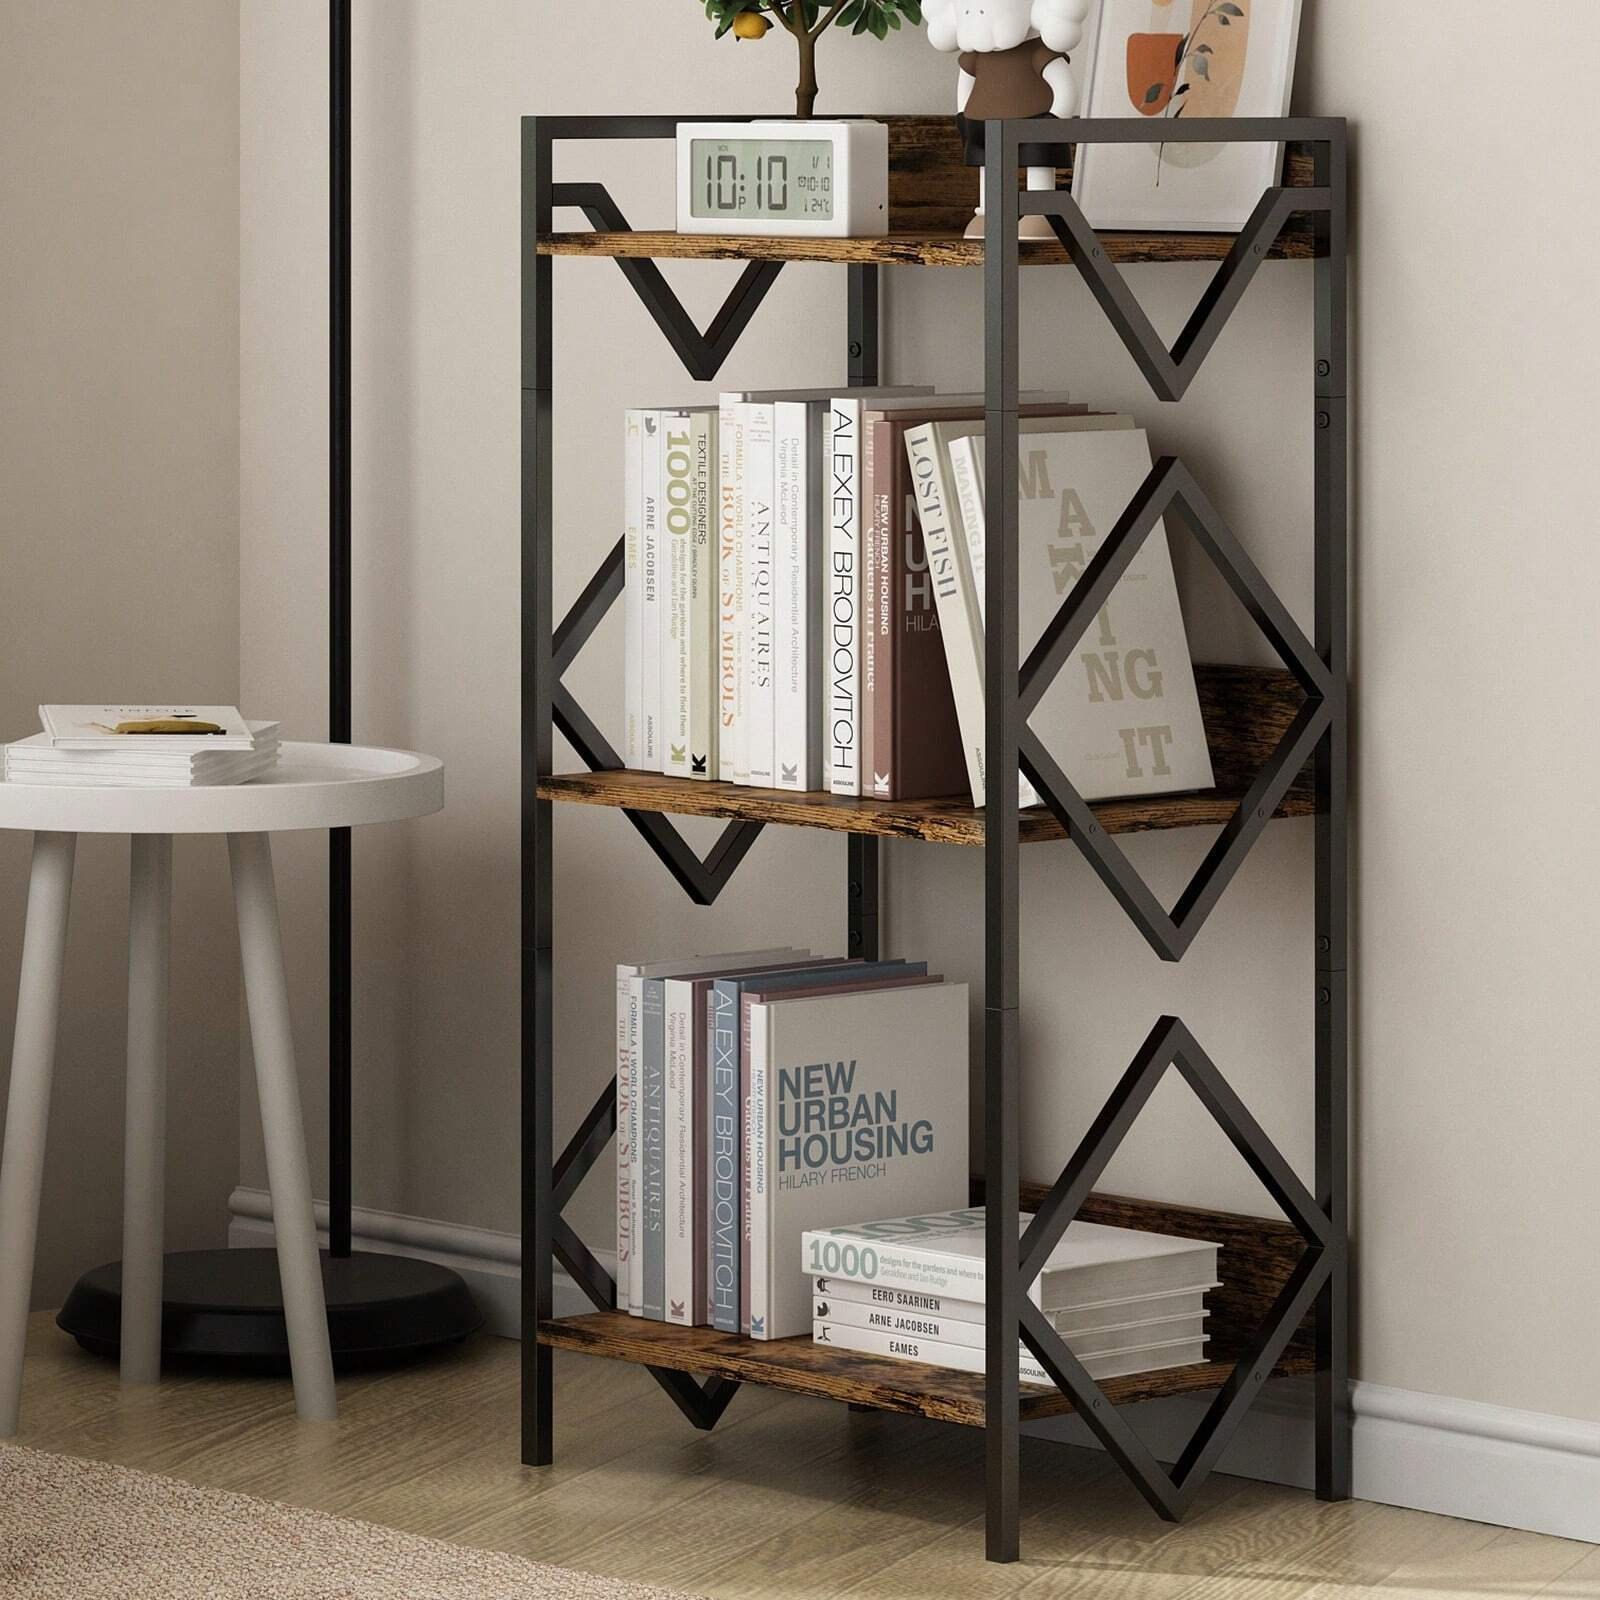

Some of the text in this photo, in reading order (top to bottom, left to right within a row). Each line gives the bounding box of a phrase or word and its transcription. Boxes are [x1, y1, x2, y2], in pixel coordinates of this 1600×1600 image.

[706, 155, 788, 210] 10:10
[666, 431, 690, 535] 1000
[735, 423, 743, 481] FORMULA
[780, 438, 789, 525] Virginia McLeod
[697, 433, 706, 545] TEXTILE DESIGNERS
[721, 485, 734, 560] BOOK
[735, 494, 743, 538] WORLD
[911, 436, 942, 517] LOST
[928, 527, 957, 597] FISH
[646, 496, 655, 602] ARNE JACOBSEN
[791, 438, 799, 693] Detail in Contemporary Residential Architecture
[755, 501, 770, 688] ANTIQUAIRES
[833, 409, 853, 768] ALEXEY BRODOVITCH
[905, 614, 939, 632] HILA
[721, 592, 734, 728] SYMBOLS
[1118, 725, 1173, 778] IT
[630, 995, 638, 1047] FORMULA
[669, 1012, 677, 1088] Virginia McLeod
[715, 990, 733, 1106] ALEXEY
[630, 1058, 638, 1098] WORLD
[778, 1060, 857, 1102] NEW
[630, 1100, 638, 1163] CHAMPIONS
[678, 1012, 686, 1239] Detail in Contemporary Residential Architecture
[756, 1069, 764, 1194] NEW URBAN HOUSING
[778, 1089, 897, 1137] URBAN
[778, 1119, 934, 1171] HOUSING
[647, 1066, 661, 1232] ANTIQUAIRES
[778, 1163, 886, 1191] HILARY FRENCH
[715, 1115, 733, 1309] BRODOVITCH
[809, 1239, 878, 1280] 1000
[869, 1313, 940, 1336] ARNE JACOBSEN
[872, 1288, 940, 1311] EERO SAARINEN
[889, 1341, 919, 1357] EAMES
